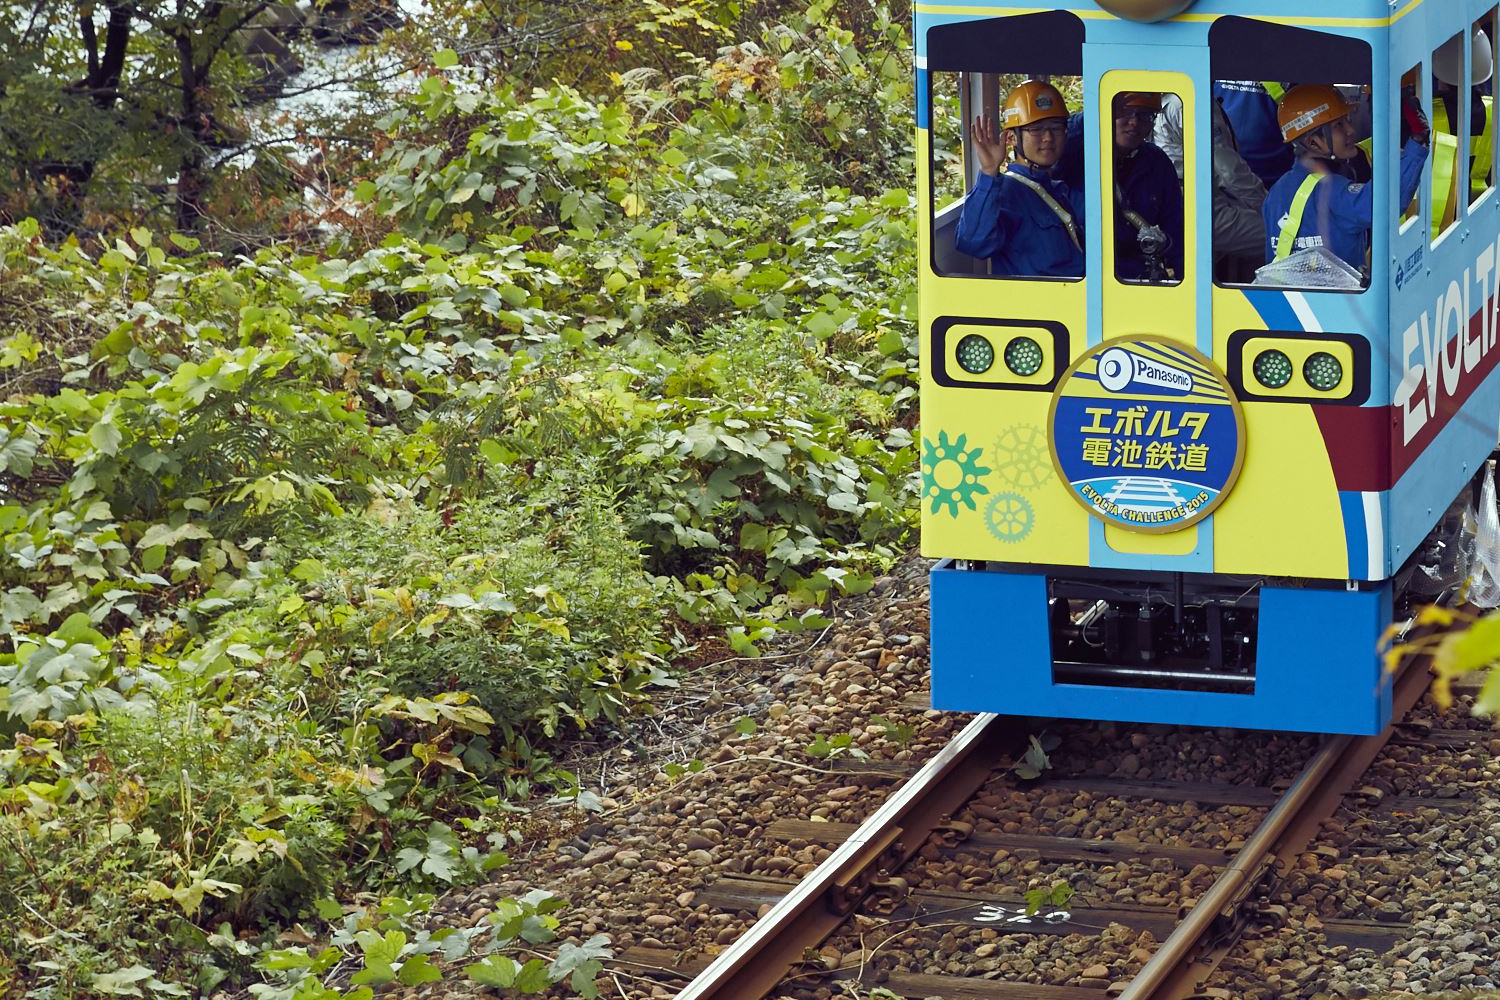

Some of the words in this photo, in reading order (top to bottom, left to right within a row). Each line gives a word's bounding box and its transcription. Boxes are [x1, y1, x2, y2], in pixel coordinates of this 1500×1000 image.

[1137, 360, 1189, 386] Panasonic
[1080, 405, 1210, 441] エボルタ
[1082, 437, 1210, 473] 電池鉄道
[1080, 483, 1120, 517] EVOLTA
[1121, 505, 1187, 524] CHALLENGE
[1186, 489, 1210, 513] 2015
